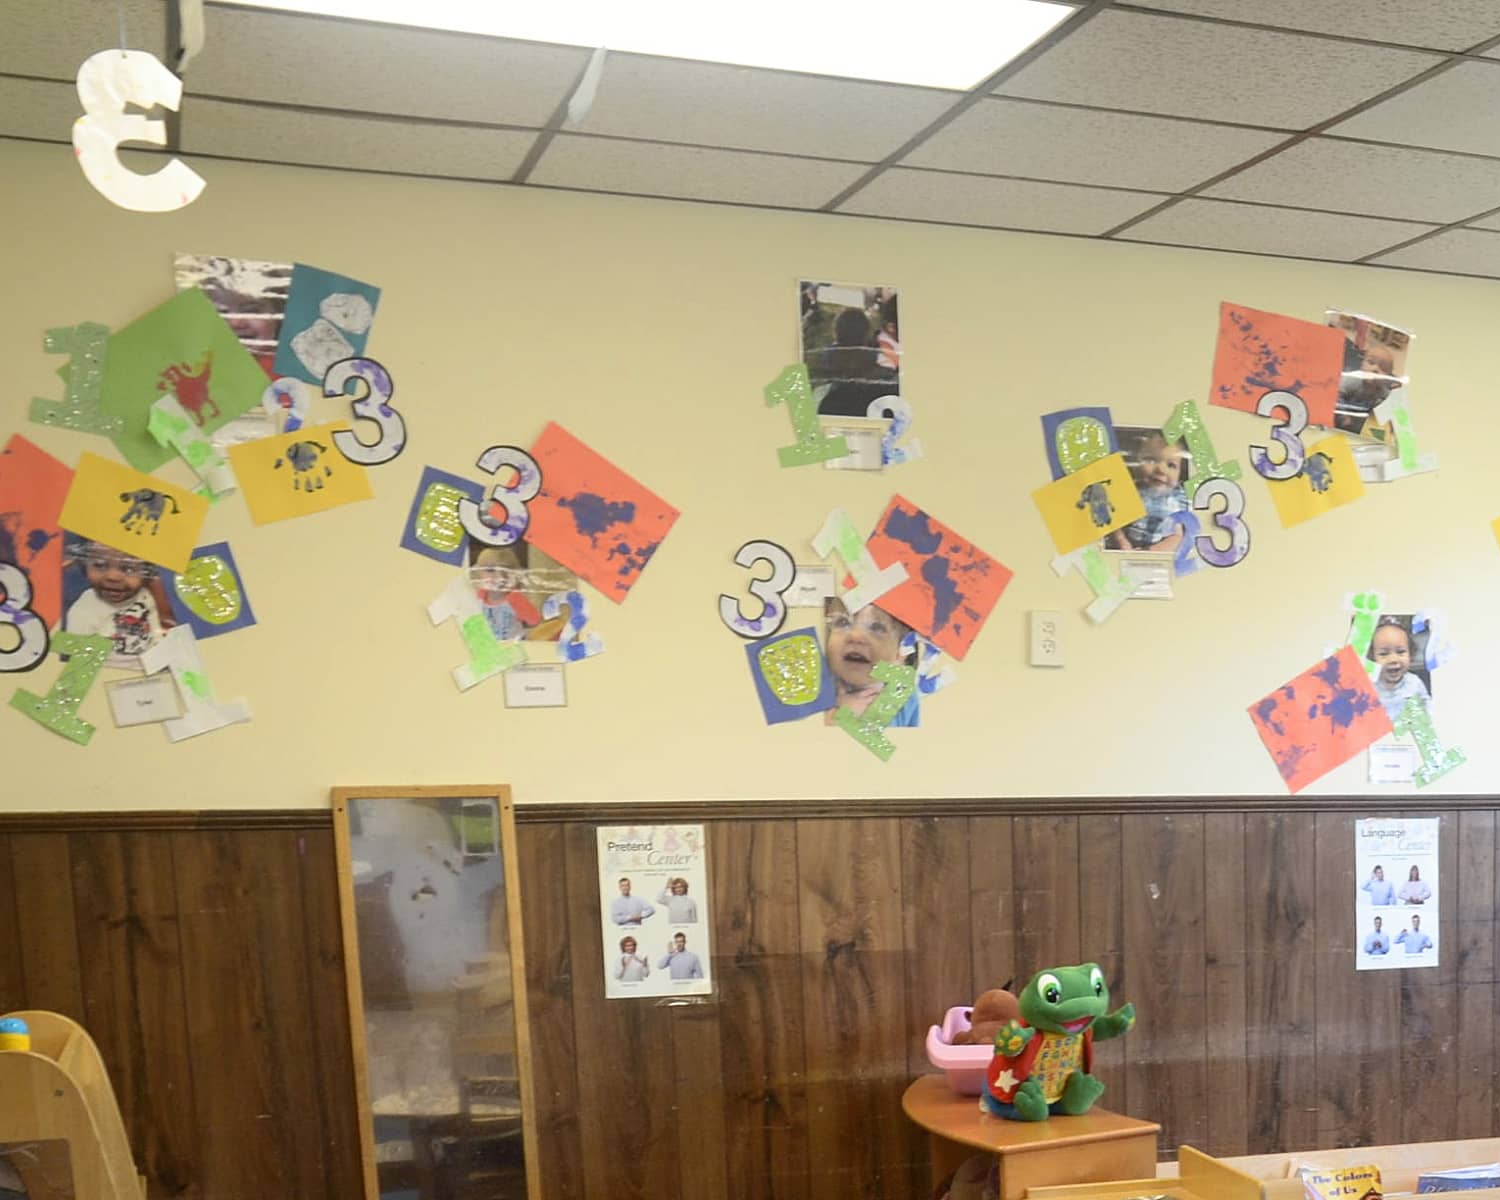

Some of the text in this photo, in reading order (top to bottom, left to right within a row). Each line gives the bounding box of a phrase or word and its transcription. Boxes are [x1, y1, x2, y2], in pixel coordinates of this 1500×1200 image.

[322, 357, 407, 466] 3
[763, 362, 850, 468] 1
[1249, 389, 1309, 481] 3
[458, 445, 543, 547] 3
[1193, 477, 1251, 568] 3
[541, 590, 607, 663] 2
[715, 539, 797, 641] 3
[10, 631, 112, 746] 1
[831, 660, 917, 763] 1
[1393, 694, 1467, 789] 1
[607, 841, 653, 852] Pretend
[647, 850, 691, 867] Center
[1361, 828, 1407, 839] Language
[1312, 1171, 1373, 1184] The Colors
[1328, 1185, 1357, 1196] of Us
